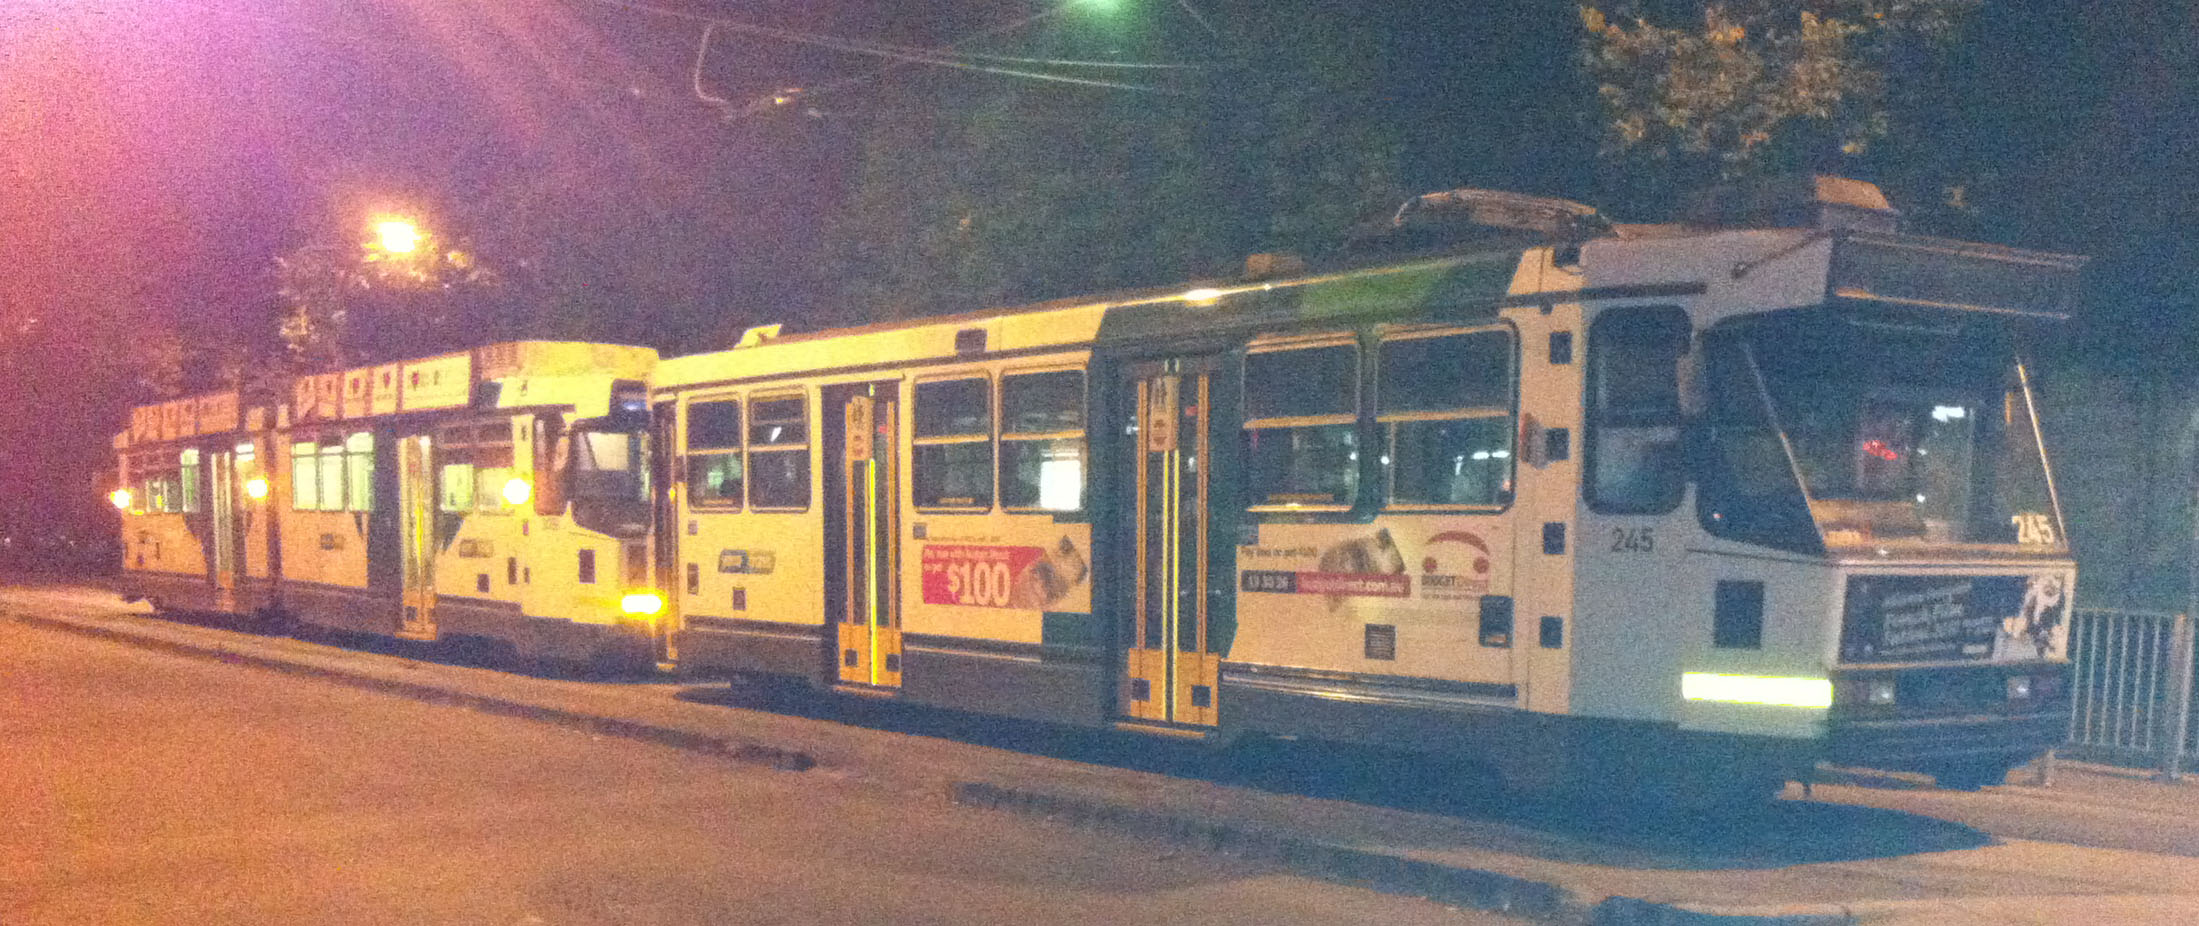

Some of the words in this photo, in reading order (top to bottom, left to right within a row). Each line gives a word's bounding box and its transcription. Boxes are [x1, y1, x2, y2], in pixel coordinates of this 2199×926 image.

[1611, 526, 1654, 552] 245
[2012, 513, 2055, 544] 245
[947, 562, 1011, 607] $100
